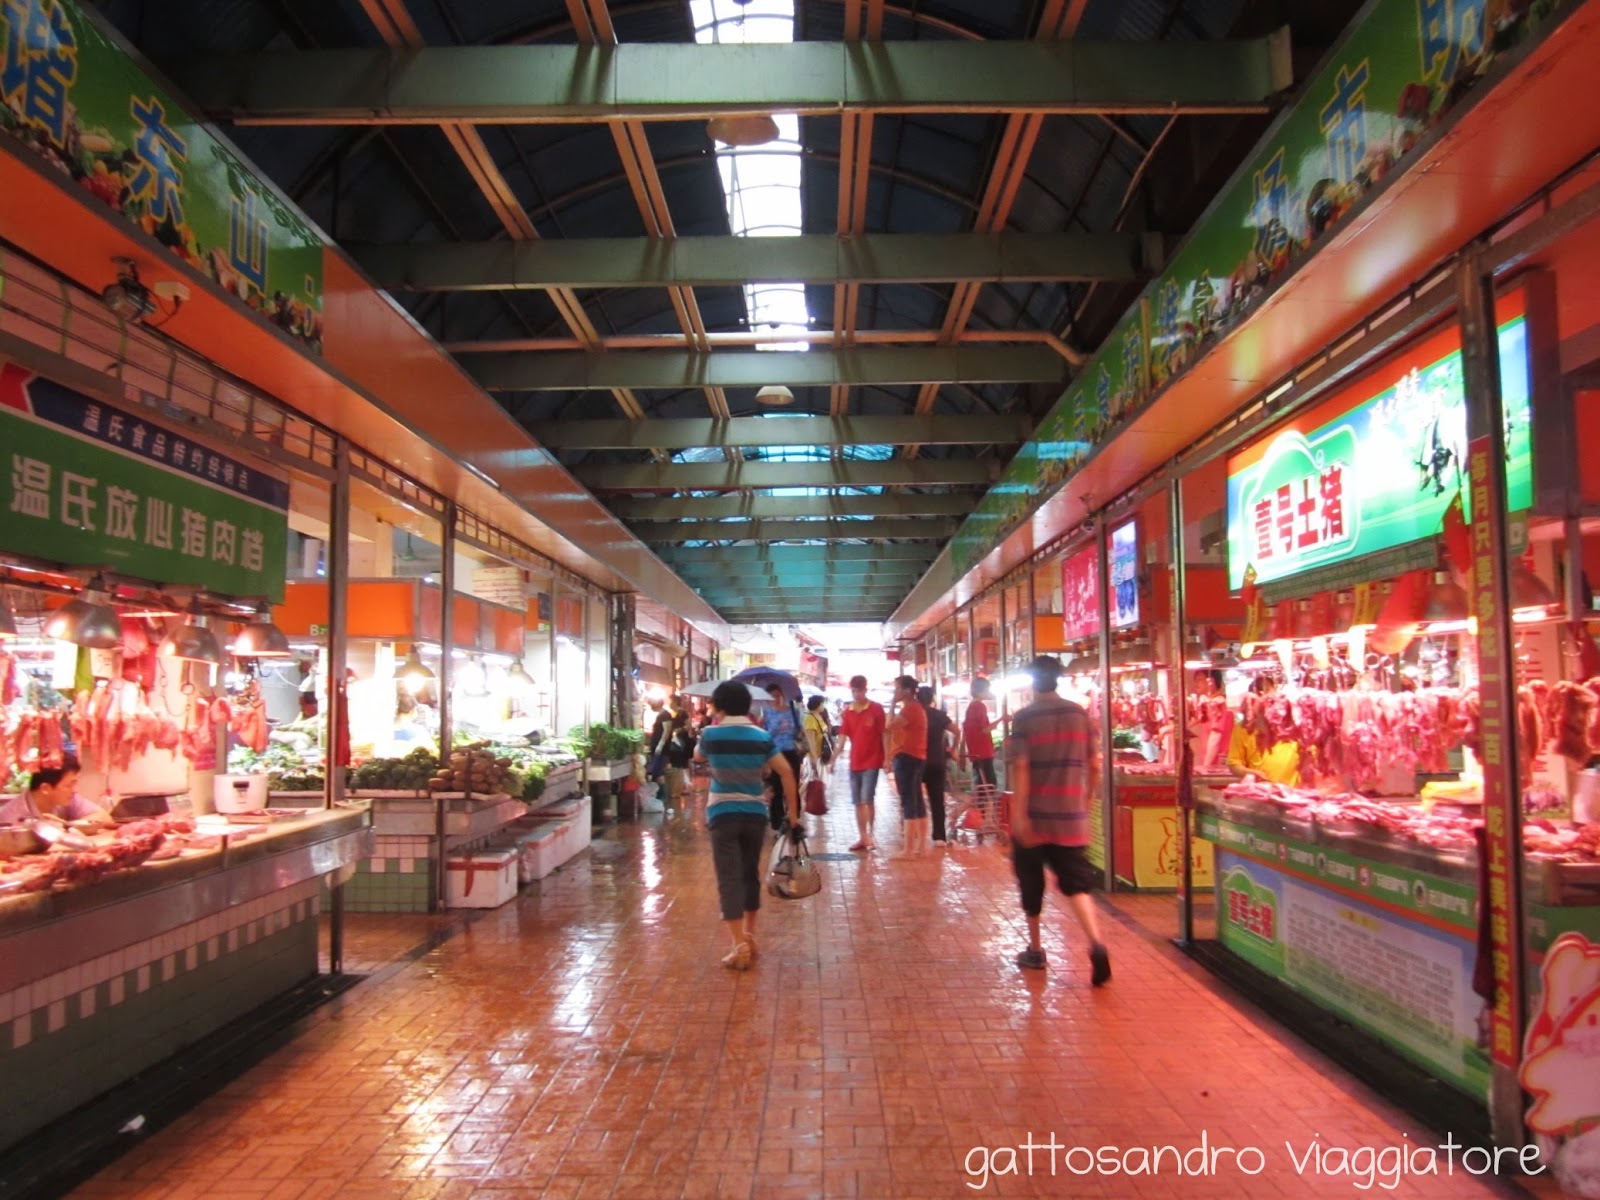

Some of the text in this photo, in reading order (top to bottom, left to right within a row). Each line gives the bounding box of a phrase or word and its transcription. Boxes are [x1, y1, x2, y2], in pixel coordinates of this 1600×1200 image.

[10, 453, 265, 572] 温氏放心猪肉档
